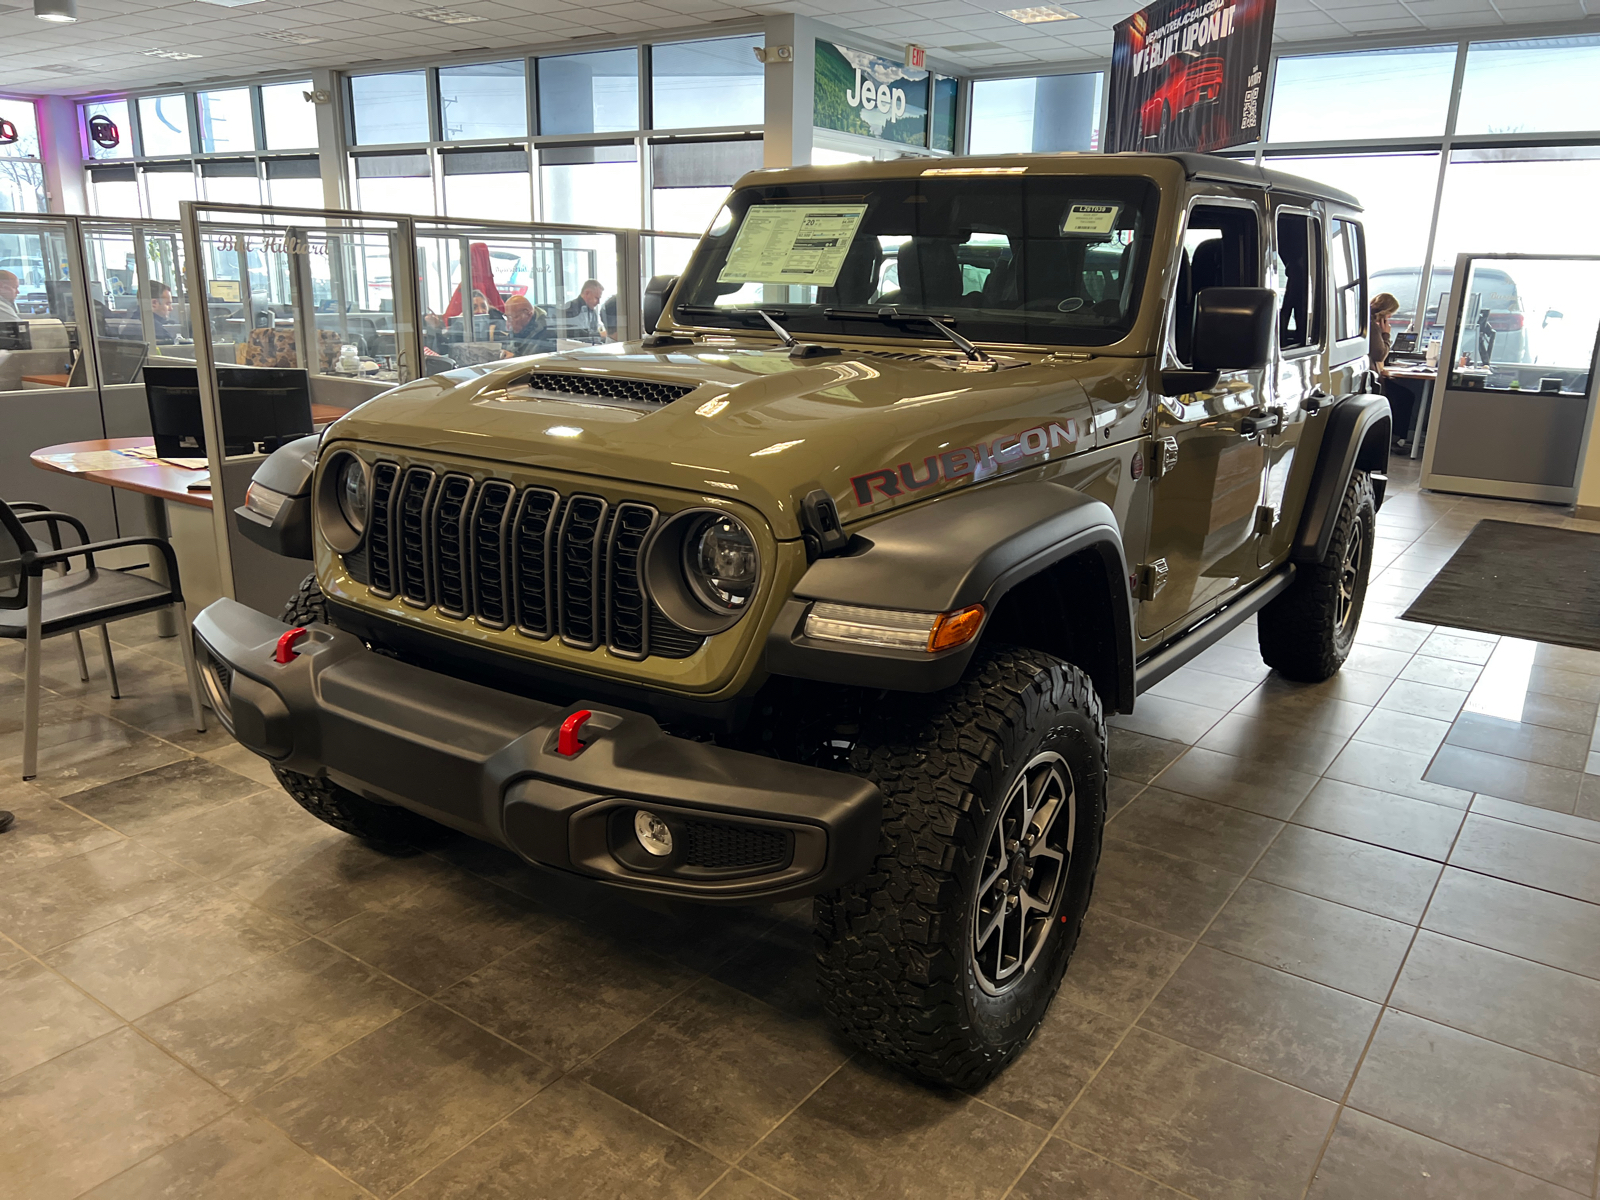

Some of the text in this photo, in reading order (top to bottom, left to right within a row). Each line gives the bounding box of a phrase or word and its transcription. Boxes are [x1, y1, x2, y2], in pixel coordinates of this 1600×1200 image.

[912, 47, 925, 68] EXIT
[1150, 33, 1179, 69] BUILT
[1181, 11, 1220, 51] UPON
[846, 67, 906, 123] Jeep
[217, 235, 330, 255] Bill Hilliard
[850, 417, 1078, 507] RUBICON
